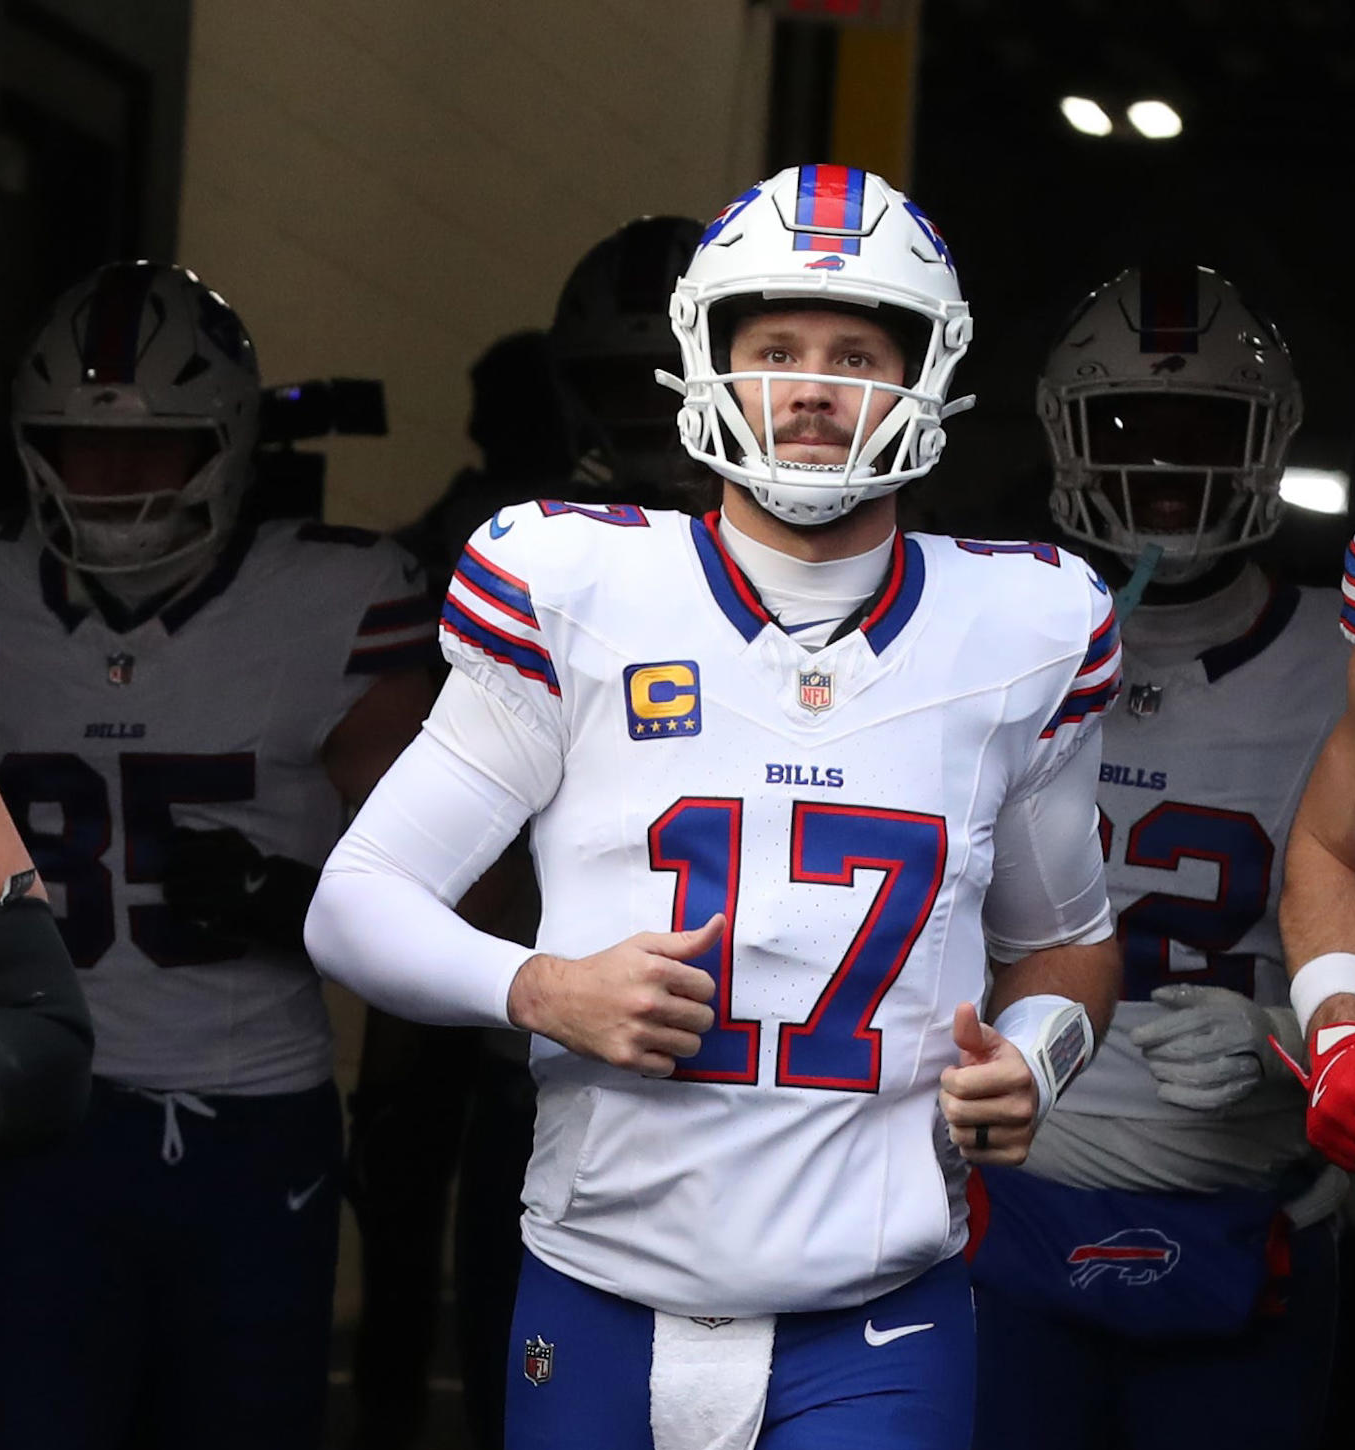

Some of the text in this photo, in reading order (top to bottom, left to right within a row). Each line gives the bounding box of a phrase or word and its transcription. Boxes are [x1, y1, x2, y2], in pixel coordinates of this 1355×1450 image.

[630, 664, 697, 720] C
[84, 723, 147, 739] BILLS
[764, 763, 845, 788] BILLS
[1098, 763, 1168, 790] BILLS
[643, 796, 948, 1094] 17
